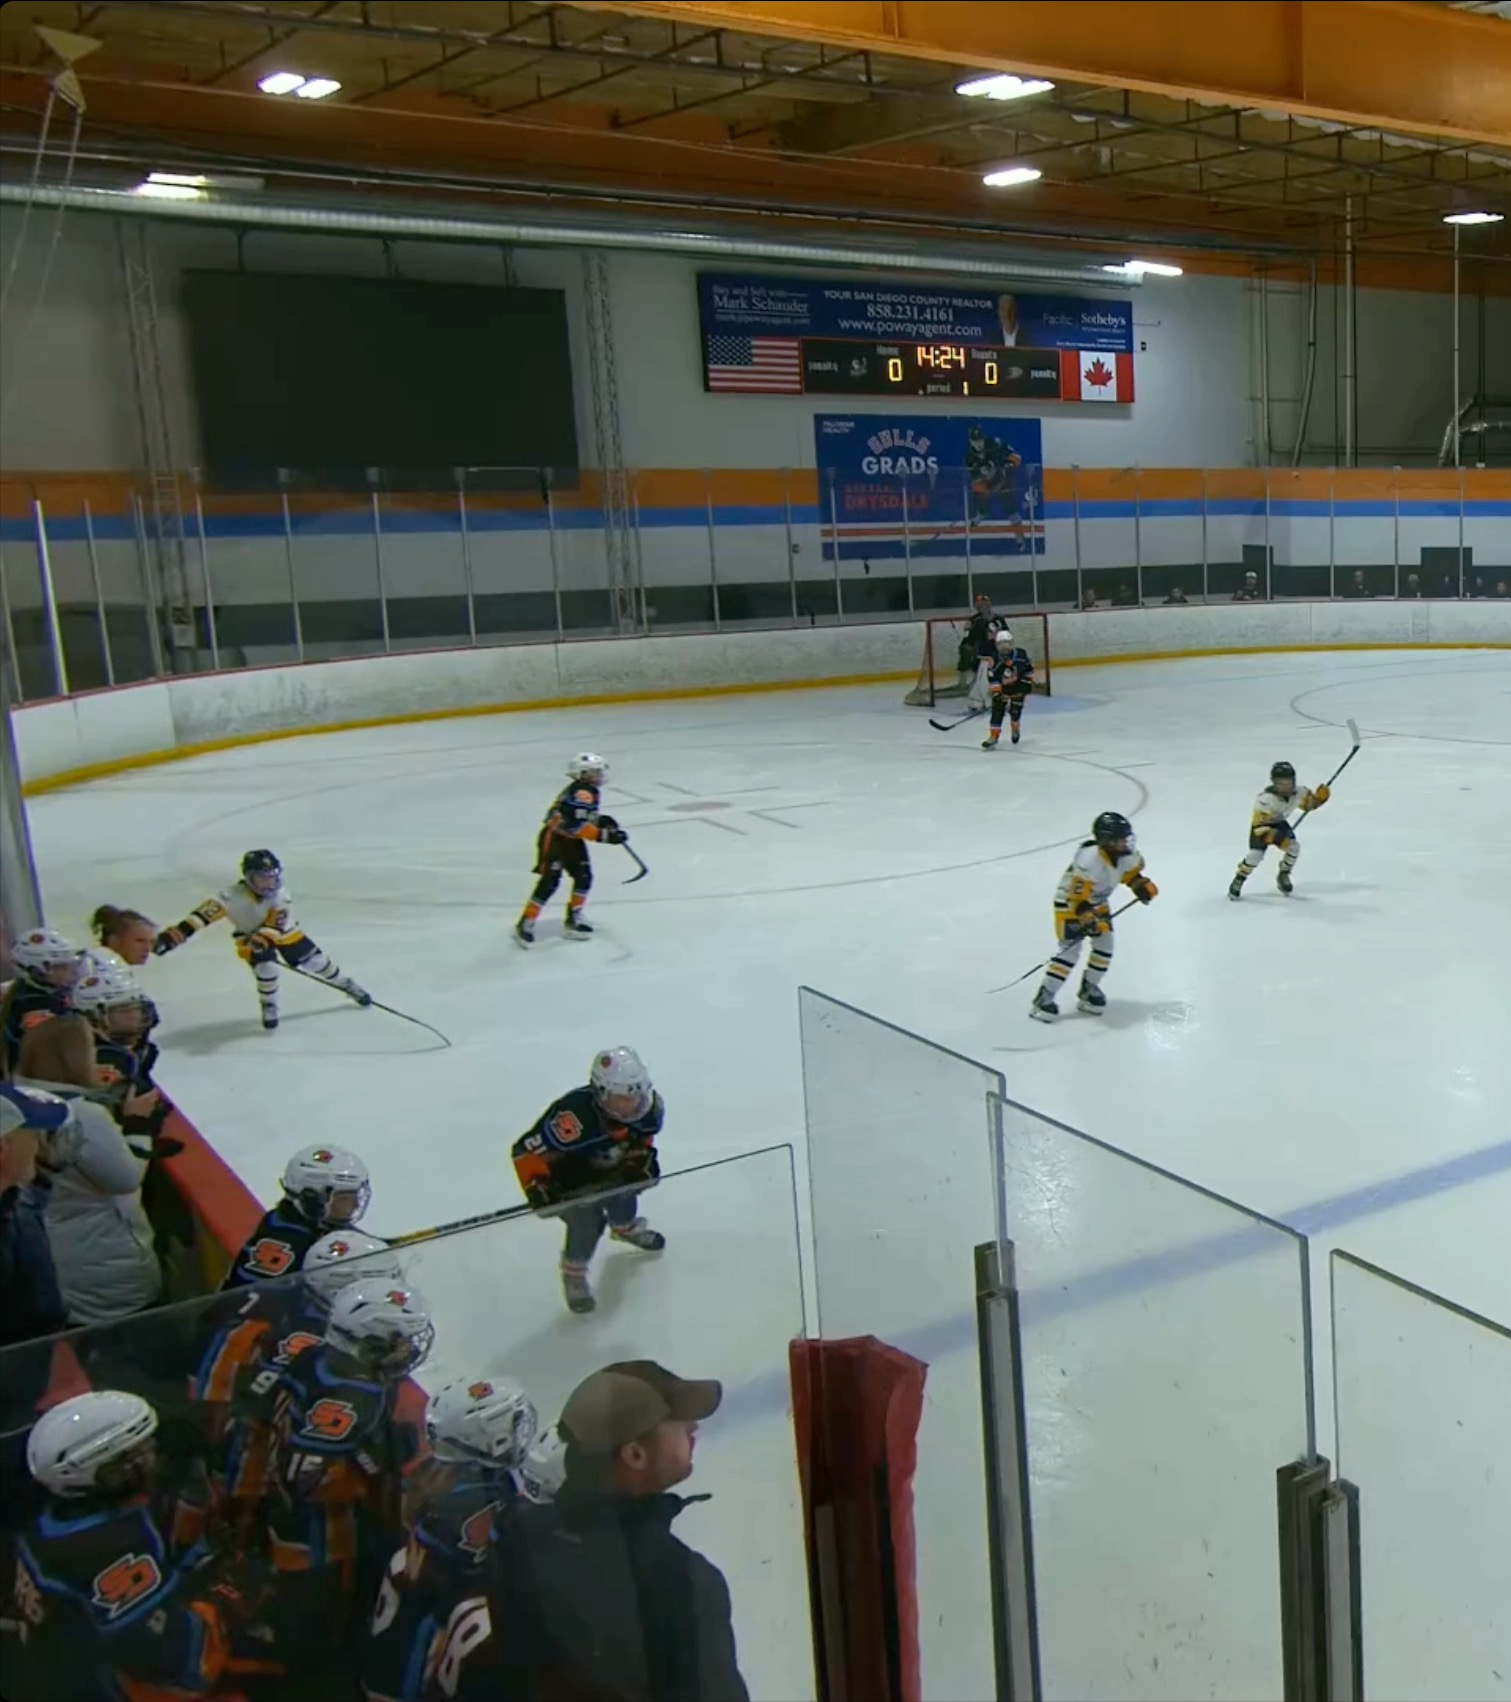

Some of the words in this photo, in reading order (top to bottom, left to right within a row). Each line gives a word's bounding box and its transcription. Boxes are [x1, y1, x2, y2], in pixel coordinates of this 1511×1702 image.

[714, 295, 749, 309] Mark
[824, 290, 850, 300] YOUR
[853, 291, 874, 301] SAN
[877, 293, 907, 303] DIEGO
[909, 295, 950, 306] COUNTY
[952, 297, 993, 309] REALTOR
[866, 302, 954, 322] 858.231.4161
[1081, 312, 1126, 328] Sotheby's
[838, 318, 982, 337] www.powayagent.com
[917, 346, 965, 369] 14:24
[888, 358, 903, 382] 0
[985, 362, 998, 385] 0
[963, 381, 969, 396] 1
[861, 456, 938, 475] GRADS
